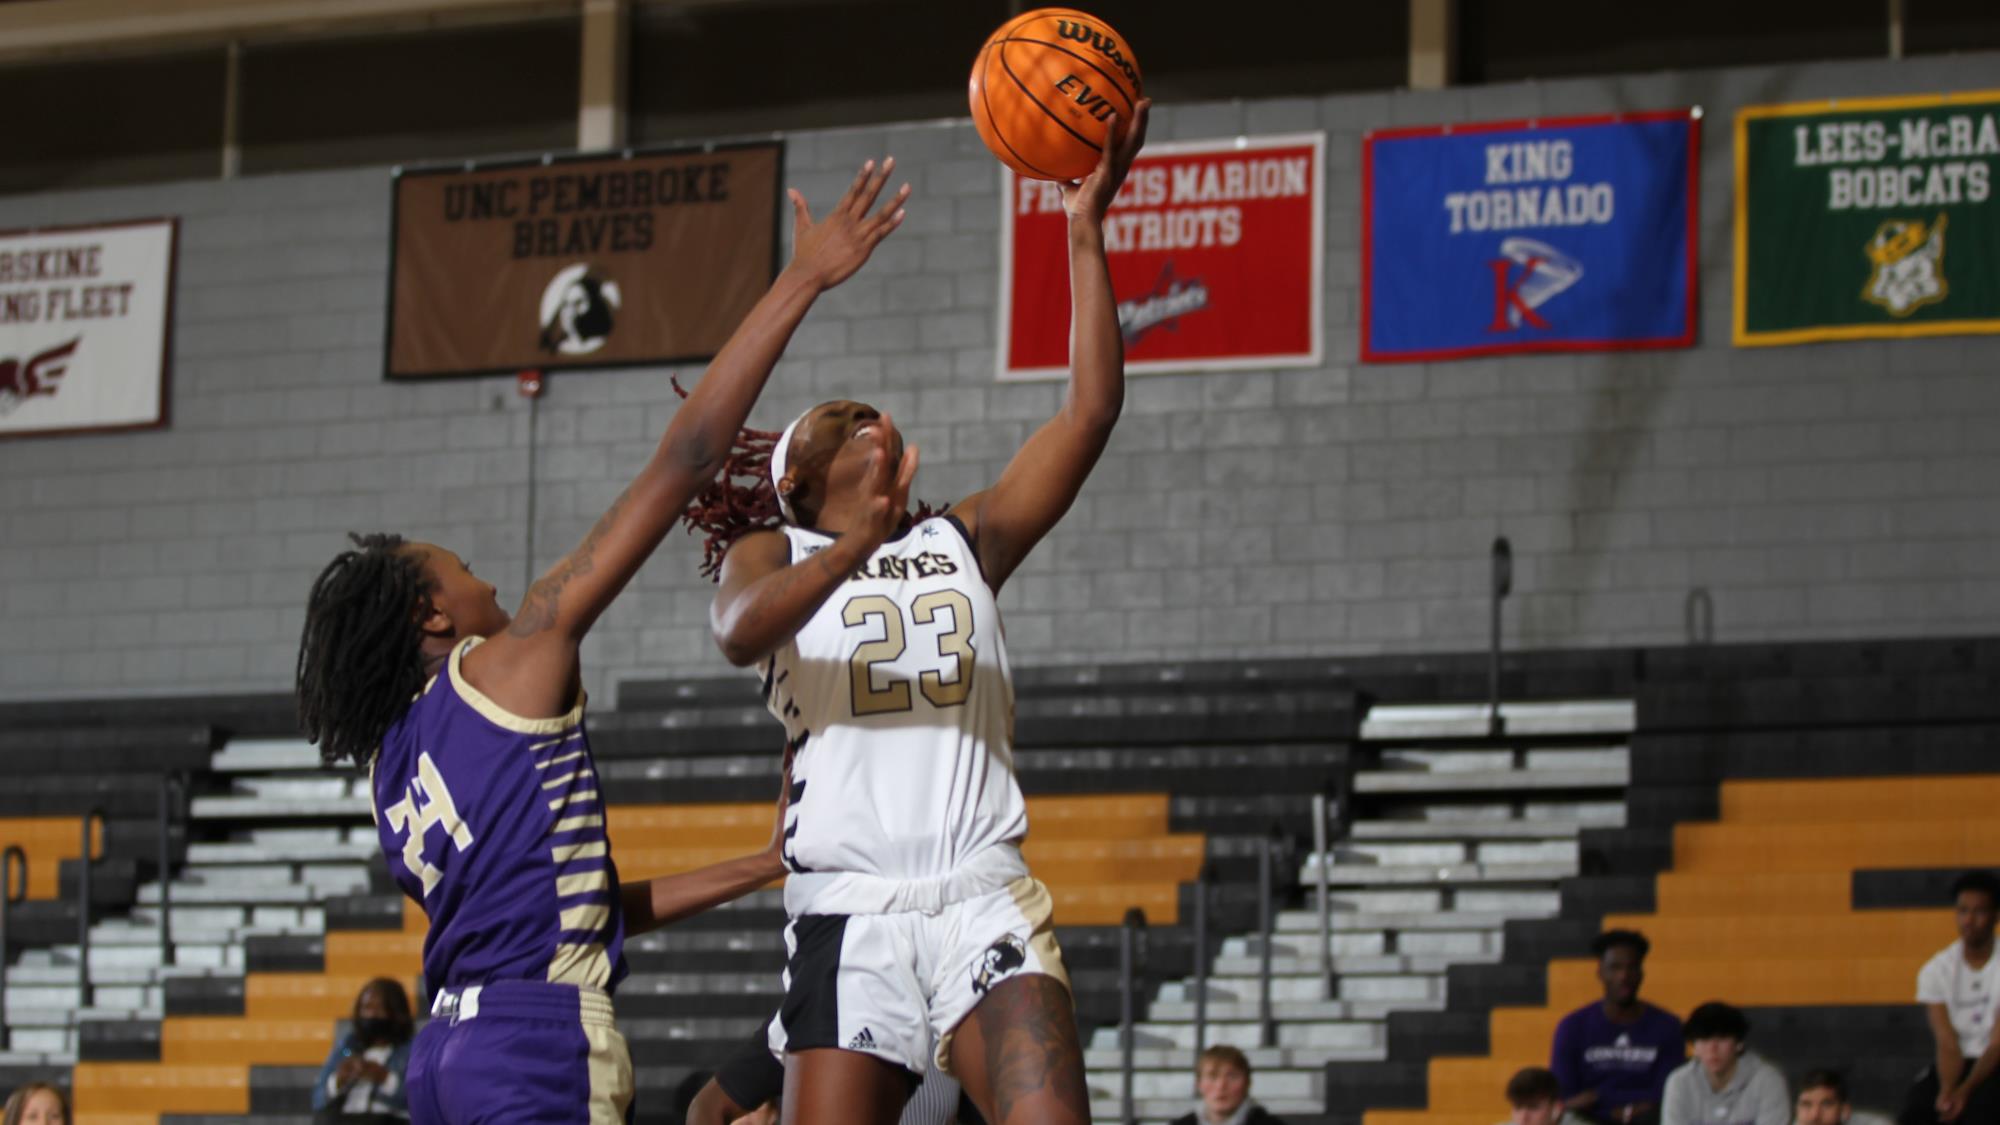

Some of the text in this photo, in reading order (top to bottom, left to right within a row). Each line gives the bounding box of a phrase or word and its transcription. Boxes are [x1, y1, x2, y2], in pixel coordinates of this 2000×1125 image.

[1055, 73, 1116, 122] EVO
[1486, 141, 1573, 183] KING
[1794, 114, 2000, 166] LEES-McRA
[444, 163, 730, 221] UNC PEMBROKE
[1018, 157, 1308, 216] FRCIS MARION
[1445, 184, 1614, 232] TORNADO
[1828, 163, 1990, 209] BOBCATS
[512, 213, 655, 258] BRAVES
[1101, 207, 1242, 253] ATRIOTS
[0, 246, 102, 282] RSKINE
[0, 283, 133, 324] NG FLEET
[849, 551, 958, 581] RAVES
[841, 588, 976, 717] 23
[384, 751, 474, 898] 24
